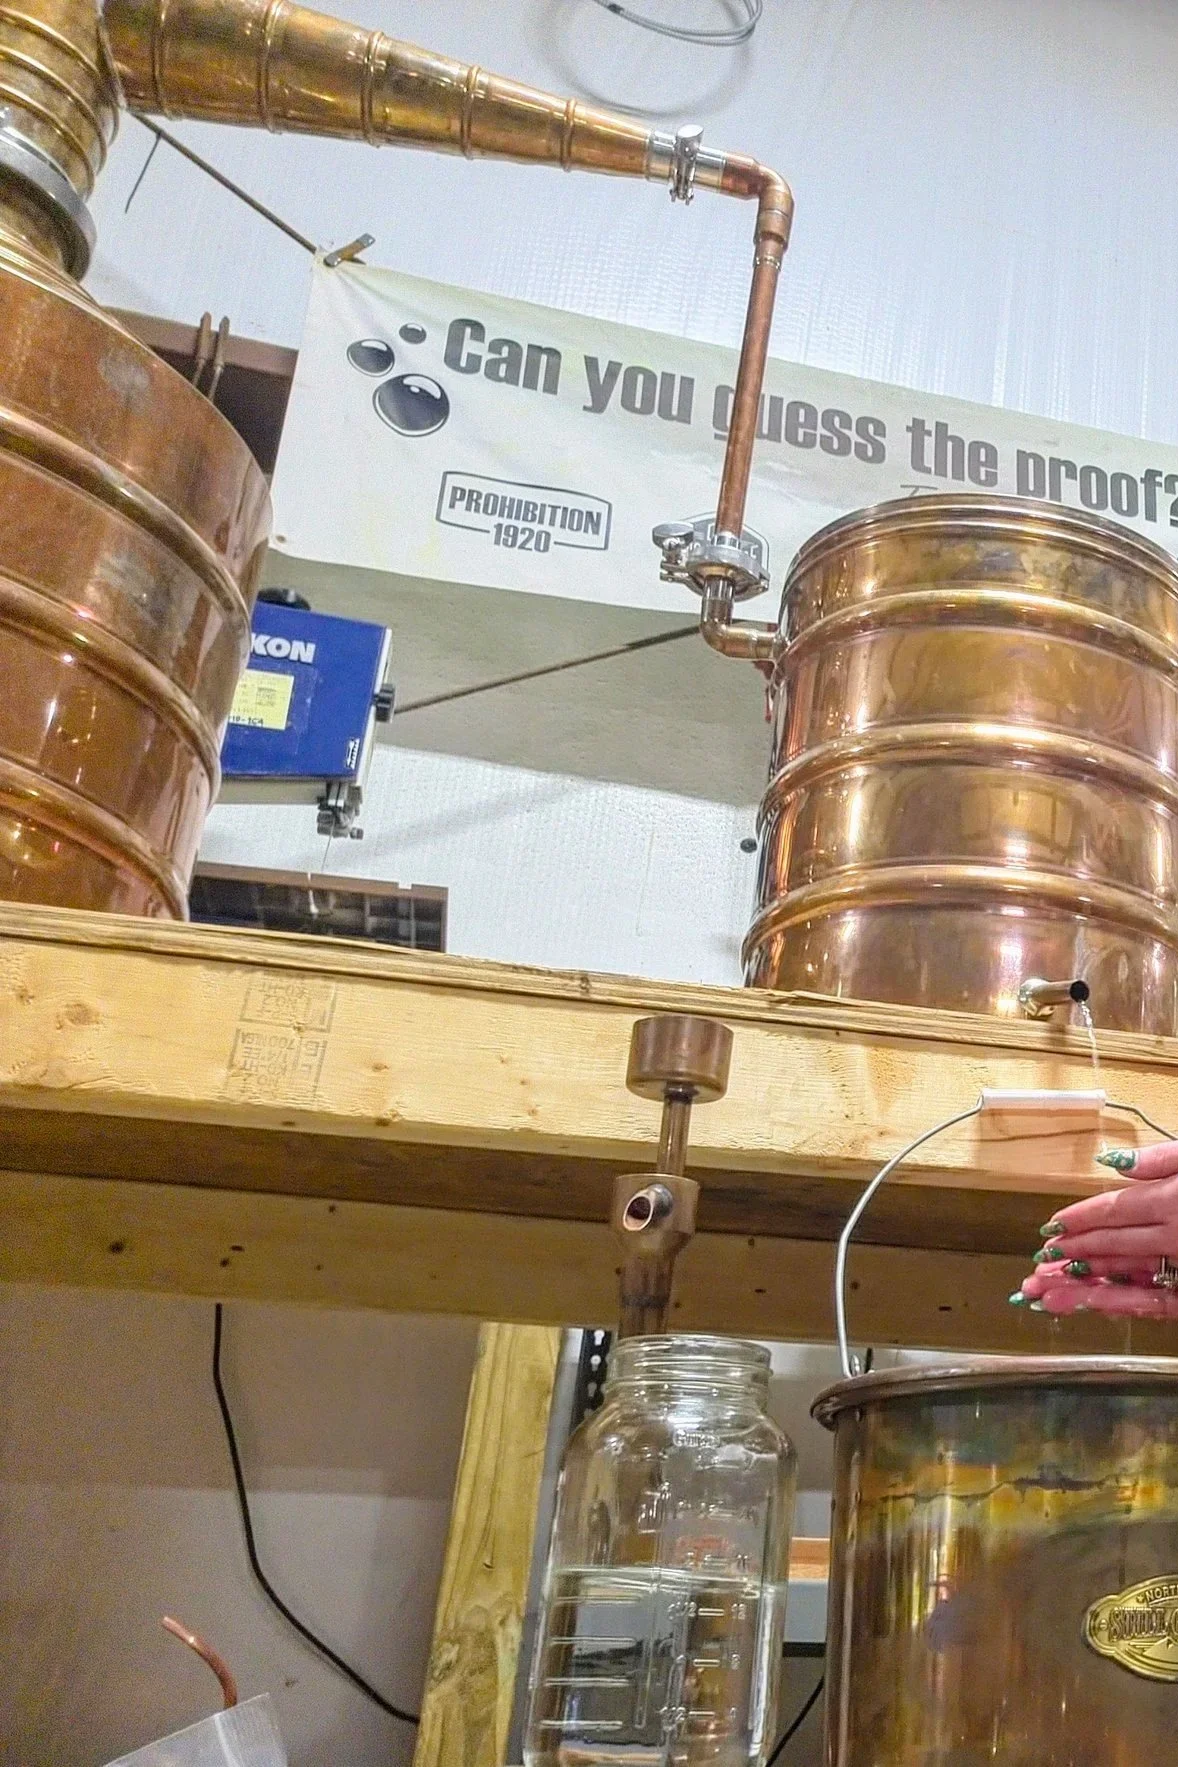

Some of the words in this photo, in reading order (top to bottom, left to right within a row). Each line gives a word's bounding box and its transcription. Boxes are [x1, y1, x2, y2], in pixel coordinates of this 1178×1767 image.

[443, 318, 562, 396] Can
[582, 354, 695, 425] you
[906, 417, 998, 489] the
[448, 485, 602, 535] PROHIBITION
[493, 522, 552, 553] 1920
